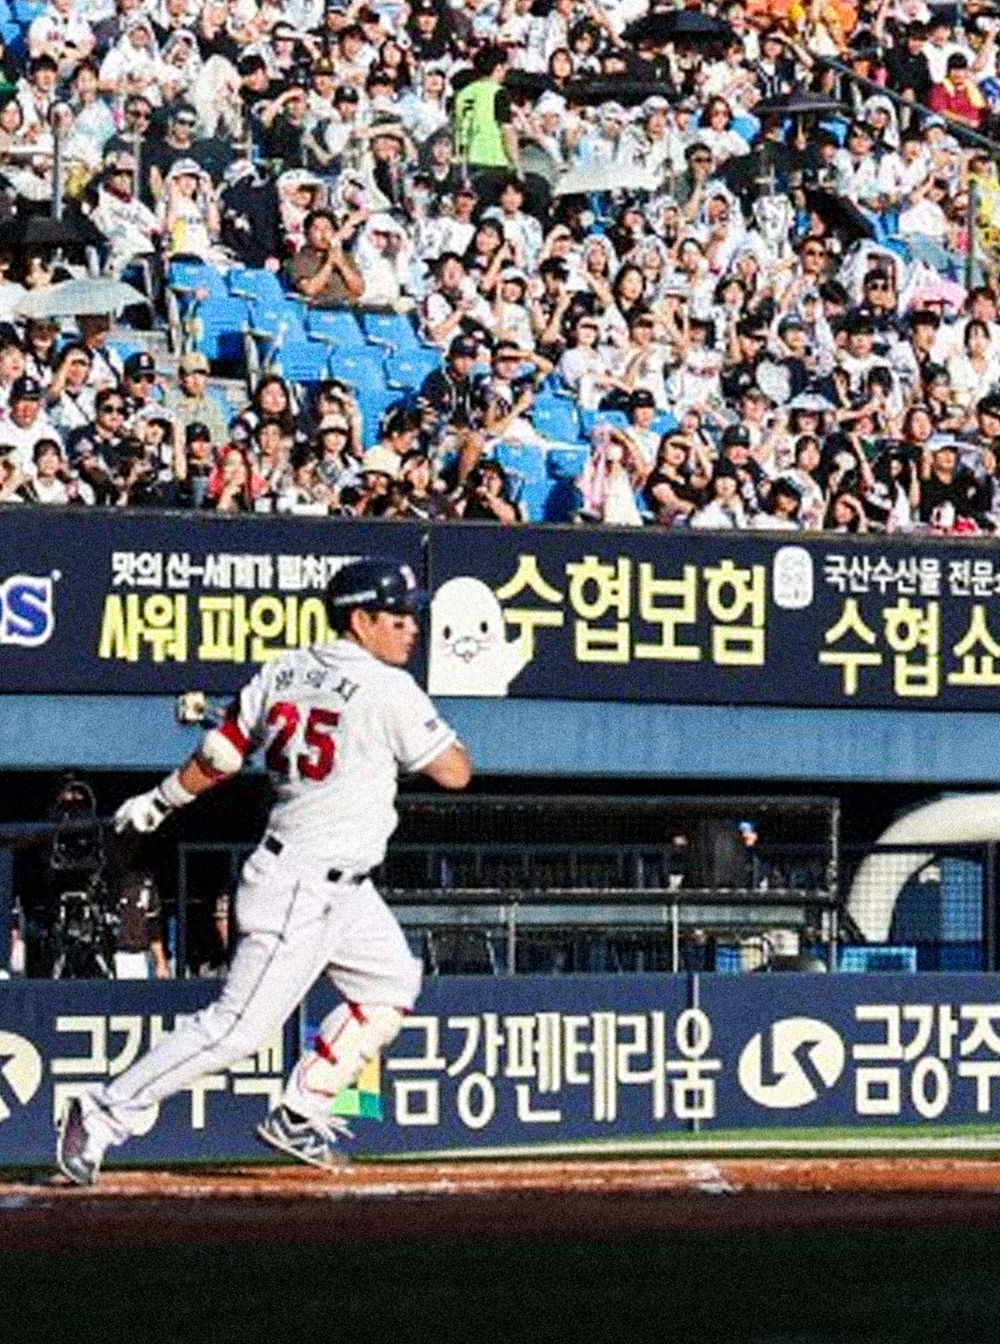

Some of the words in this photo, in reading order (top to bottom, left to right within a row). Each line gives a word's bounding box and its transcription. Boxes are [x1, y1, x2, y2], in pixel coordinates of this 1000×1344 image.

[111, 552, 162, 588] 맛의
[825, 555, 940, 596] 국산수산물
[949, 559, 1000, 597] 전문
[99, 594, 189, 663] 사워
[496, 555, 766, 666] 수협보험
[264, 700, 343, 782] 25
[386, 1008, 722, 1129] 금강펜테리움
